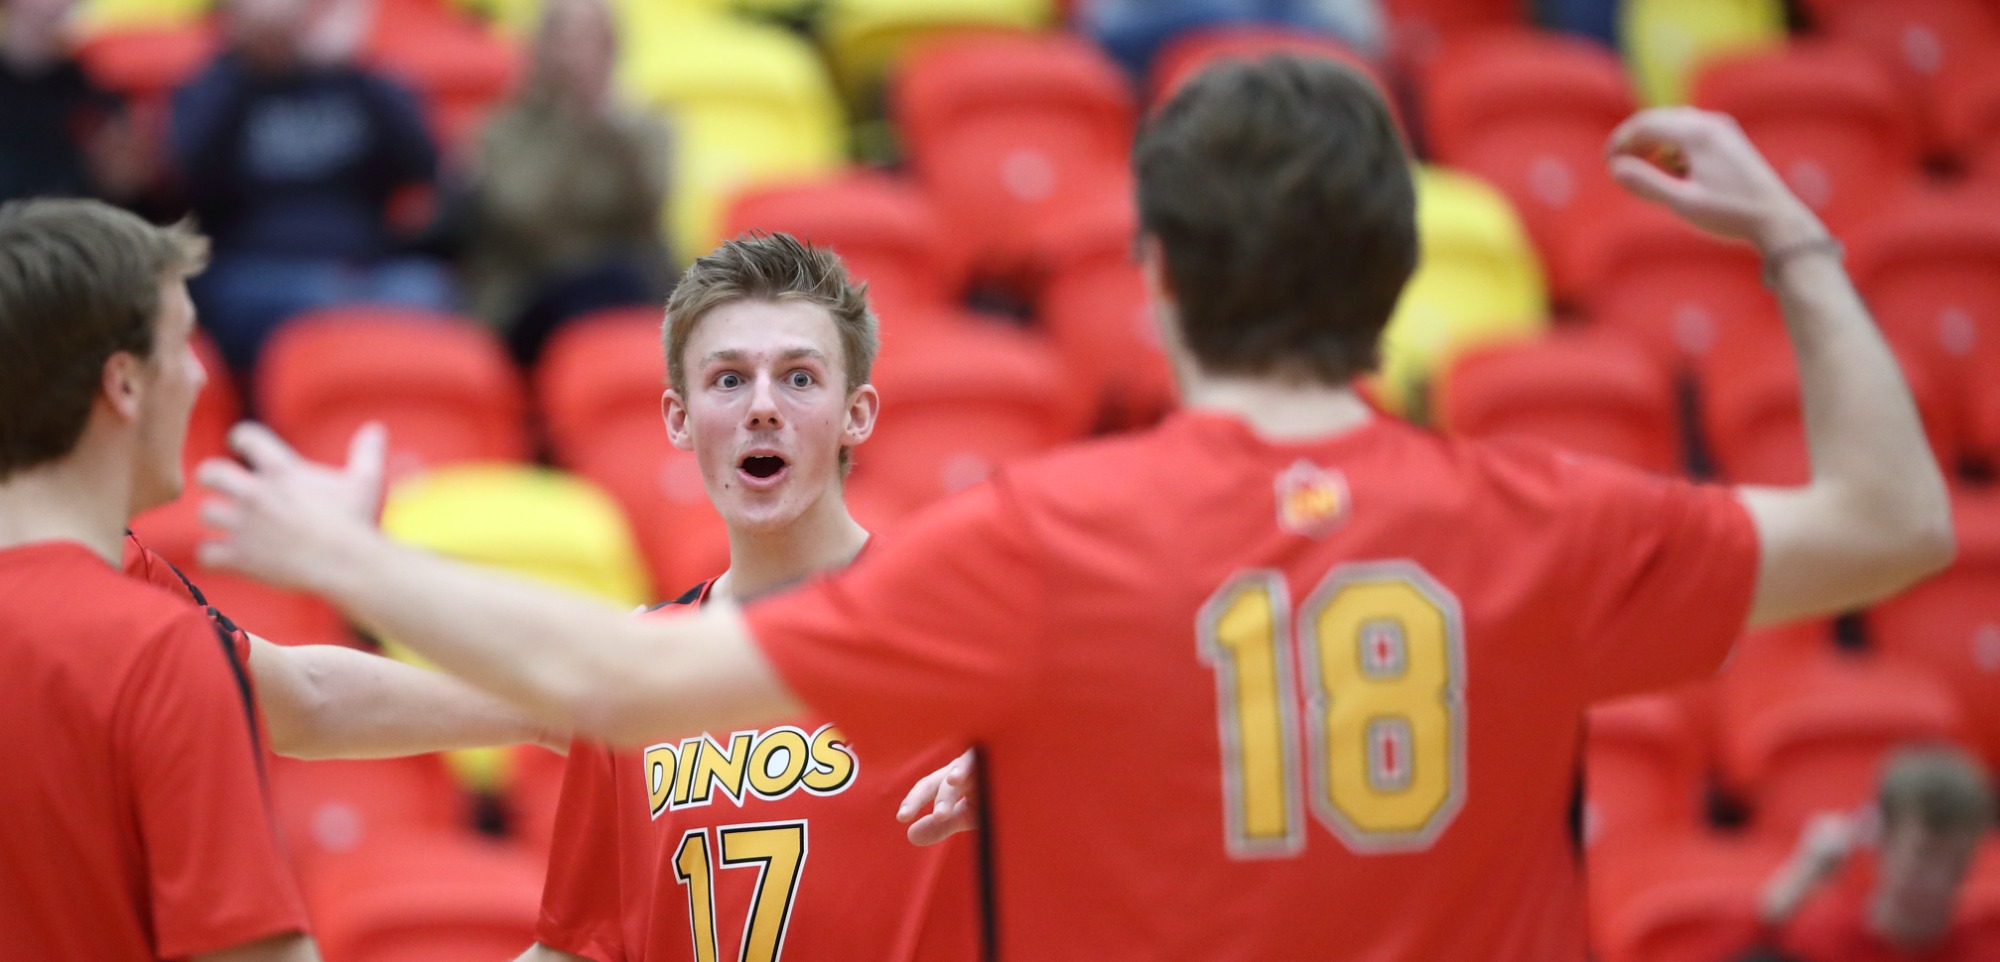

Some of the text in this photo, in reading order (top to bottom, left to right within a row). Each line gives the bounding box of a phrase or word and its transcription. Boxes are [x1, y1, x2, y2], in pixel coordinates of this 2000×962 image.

[644, 723, 858, 820] DINOS
[1197, 560, 1467, 857] 18
[672, 819, 808, 962] 17
